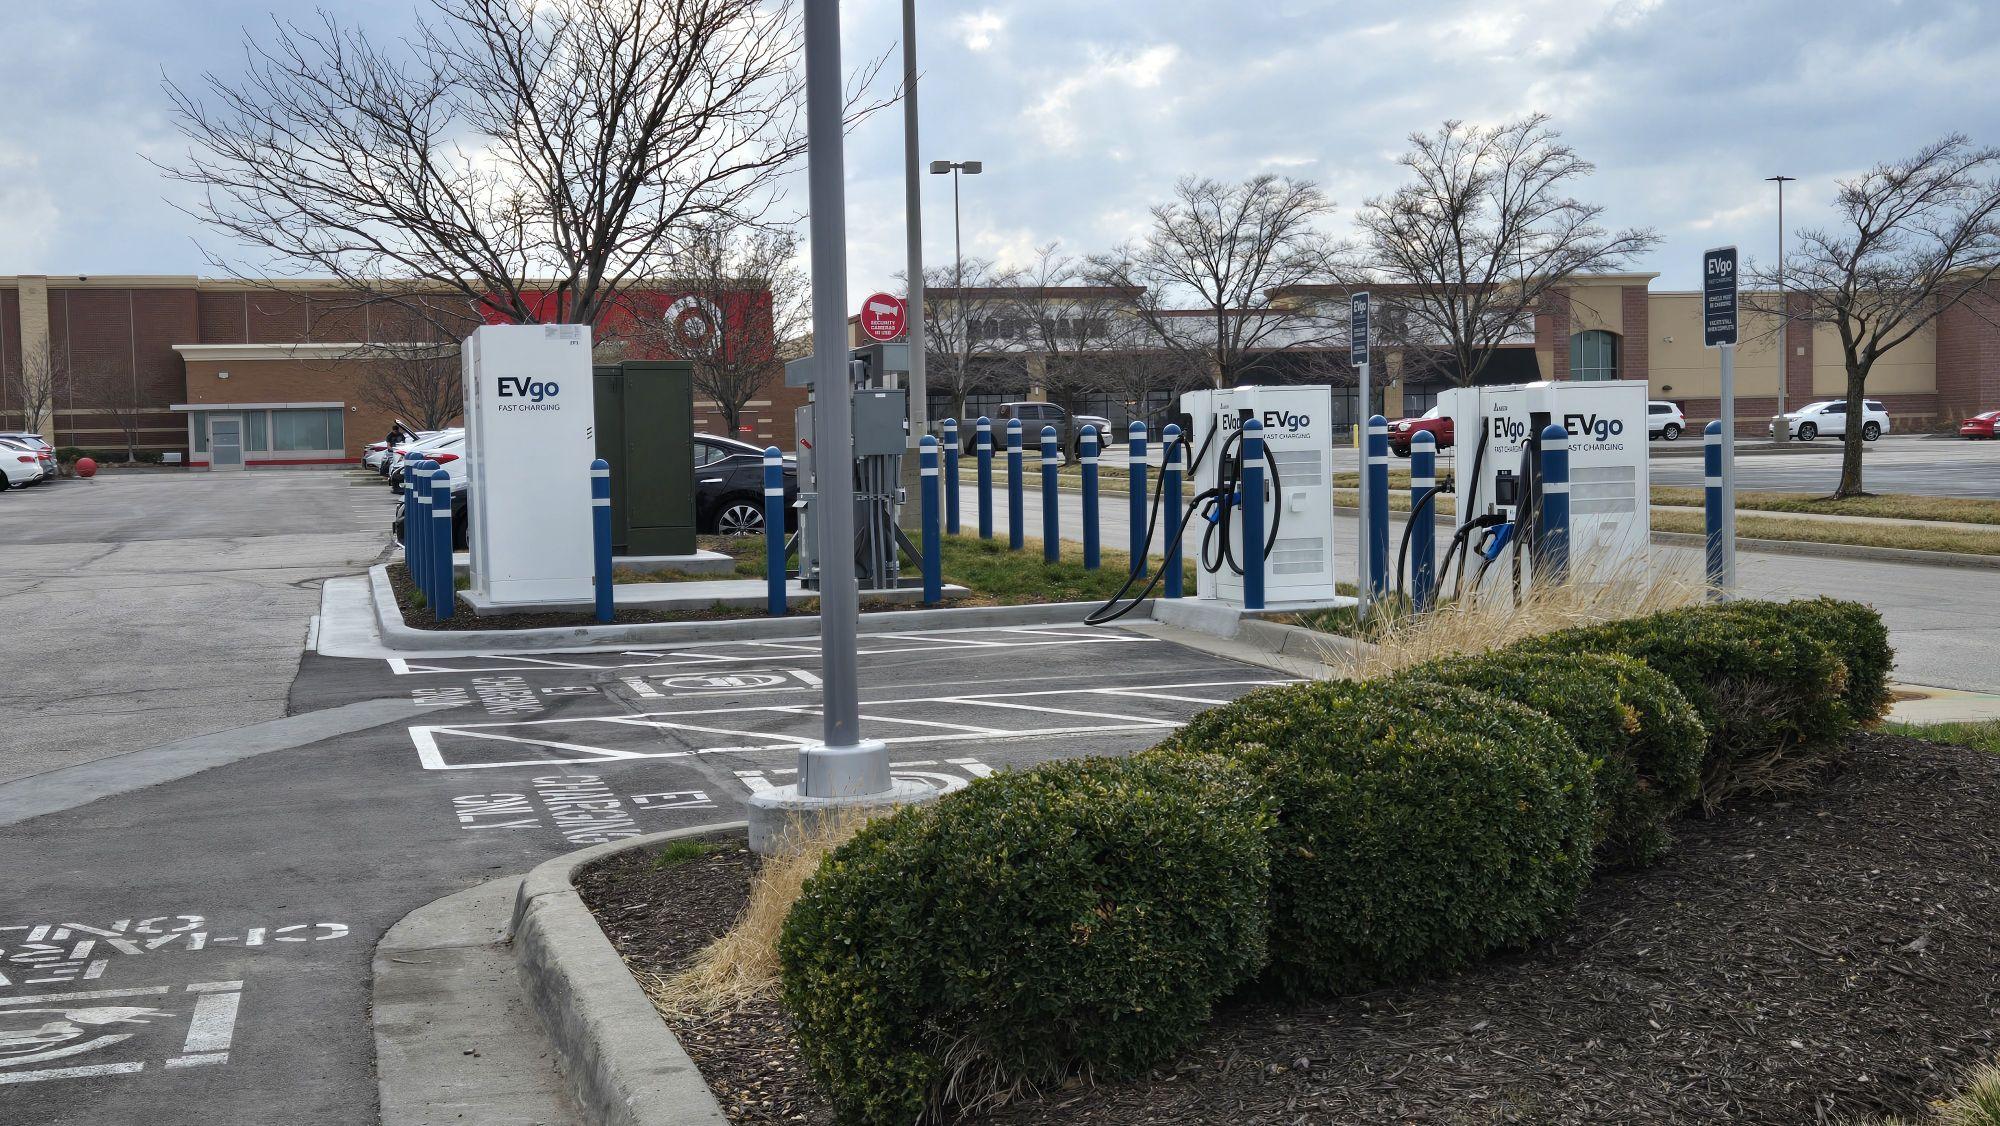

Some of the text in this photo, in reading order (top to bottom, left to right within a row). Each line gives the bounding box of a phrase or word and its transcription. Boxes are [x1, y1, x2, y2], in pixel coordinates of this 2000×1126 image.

[1708, 257, 1732, 276] EVgo
[1354, 299, 1367, 315] EVgo
[497, 376, 560, 402] EVgo
[498, 403, 560, 412] FAST CHARGING
[1263, 410, 1311, 432] EVgo
[1494, 416, 1525, 444] EVgo
[1563, 413, 1624, 442] EVgo
[1567, 443, 1624, 452] AST CHARGING
[452, 793, 543, 829] ONLY
[531, 775, 642, 844] CHARGING
[630, 790, 719, 810] EV
